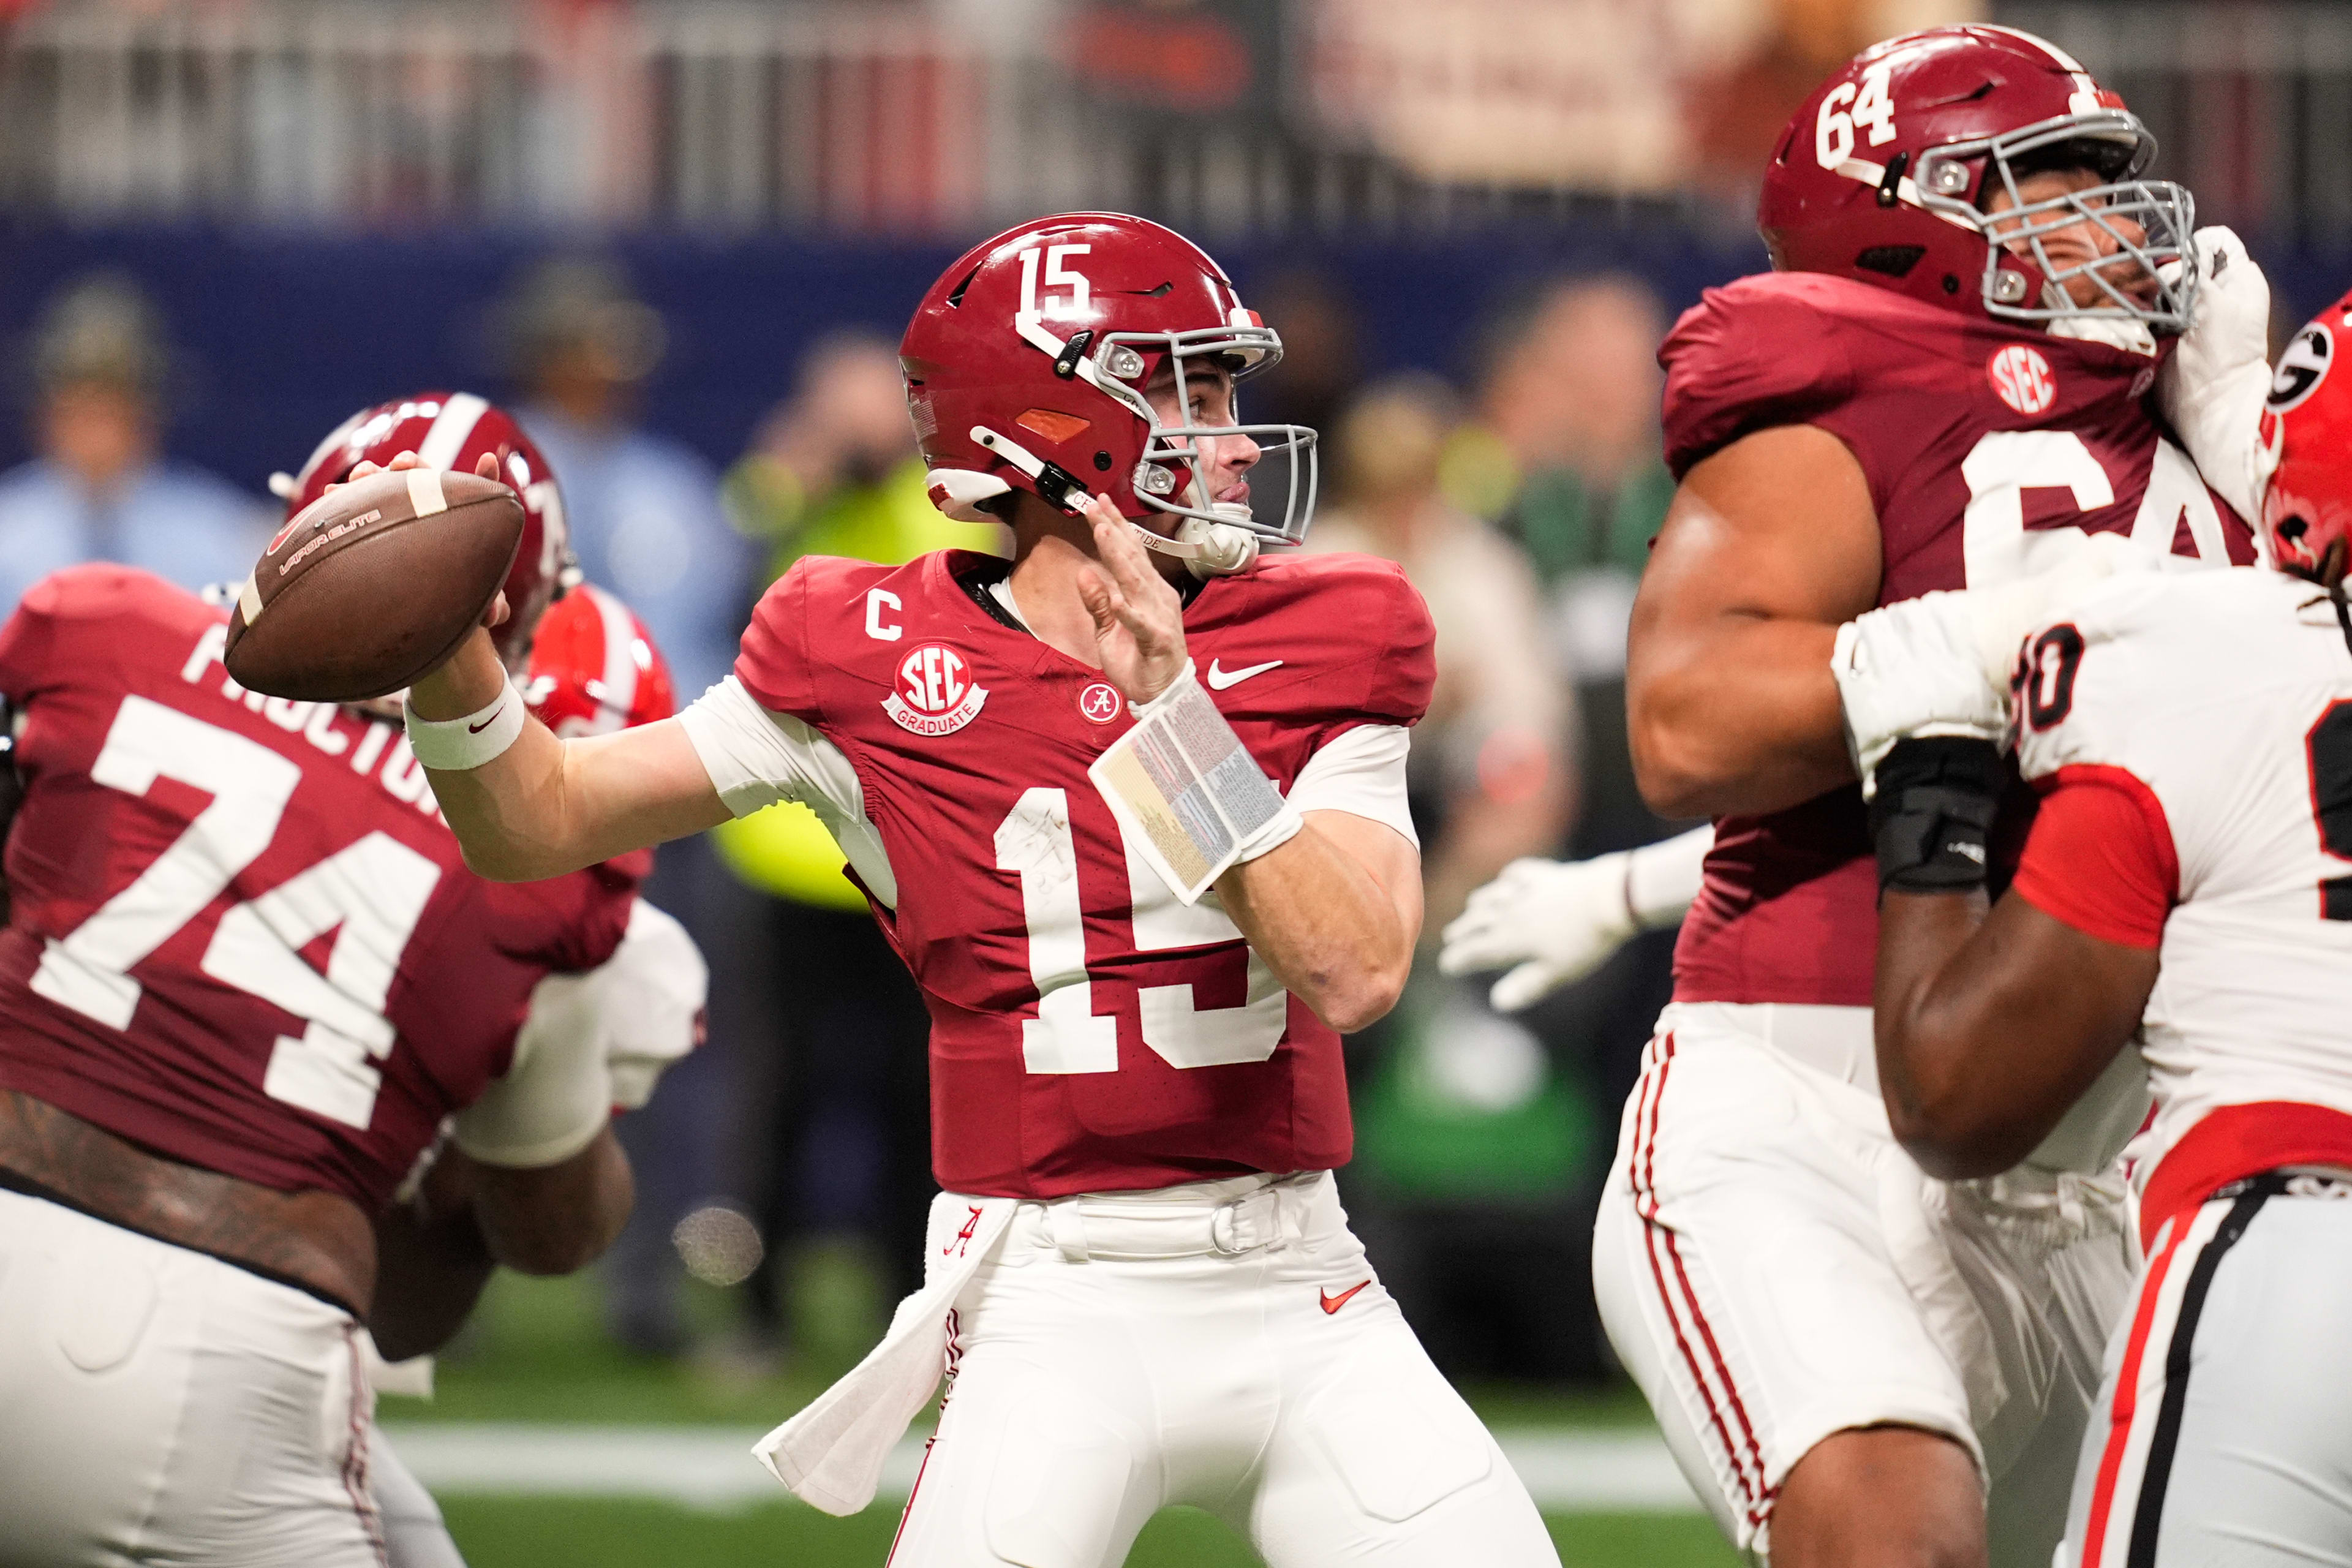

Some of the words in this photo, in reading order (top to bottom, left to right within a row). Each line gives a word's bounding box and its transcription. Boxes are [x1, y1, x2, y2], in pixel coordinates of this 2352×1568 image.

[1816, 65, 1897, 170] 64
[1016, 244, 1091, 323] 15
[1992, 347, 2054, 413] SEC
[279, 533, 329, 576] VAPOR
[328, 509, 382, 540] ELITE
[865, 587, 902, 641] C
[901, 647, 964, 711] SEC
[1087, 690, 1112, 714] A
[897, 703, 975, 733] GRADUATE
[29, 694, 442, 1130] 74
[993, 780, 1287, 1074] 15
